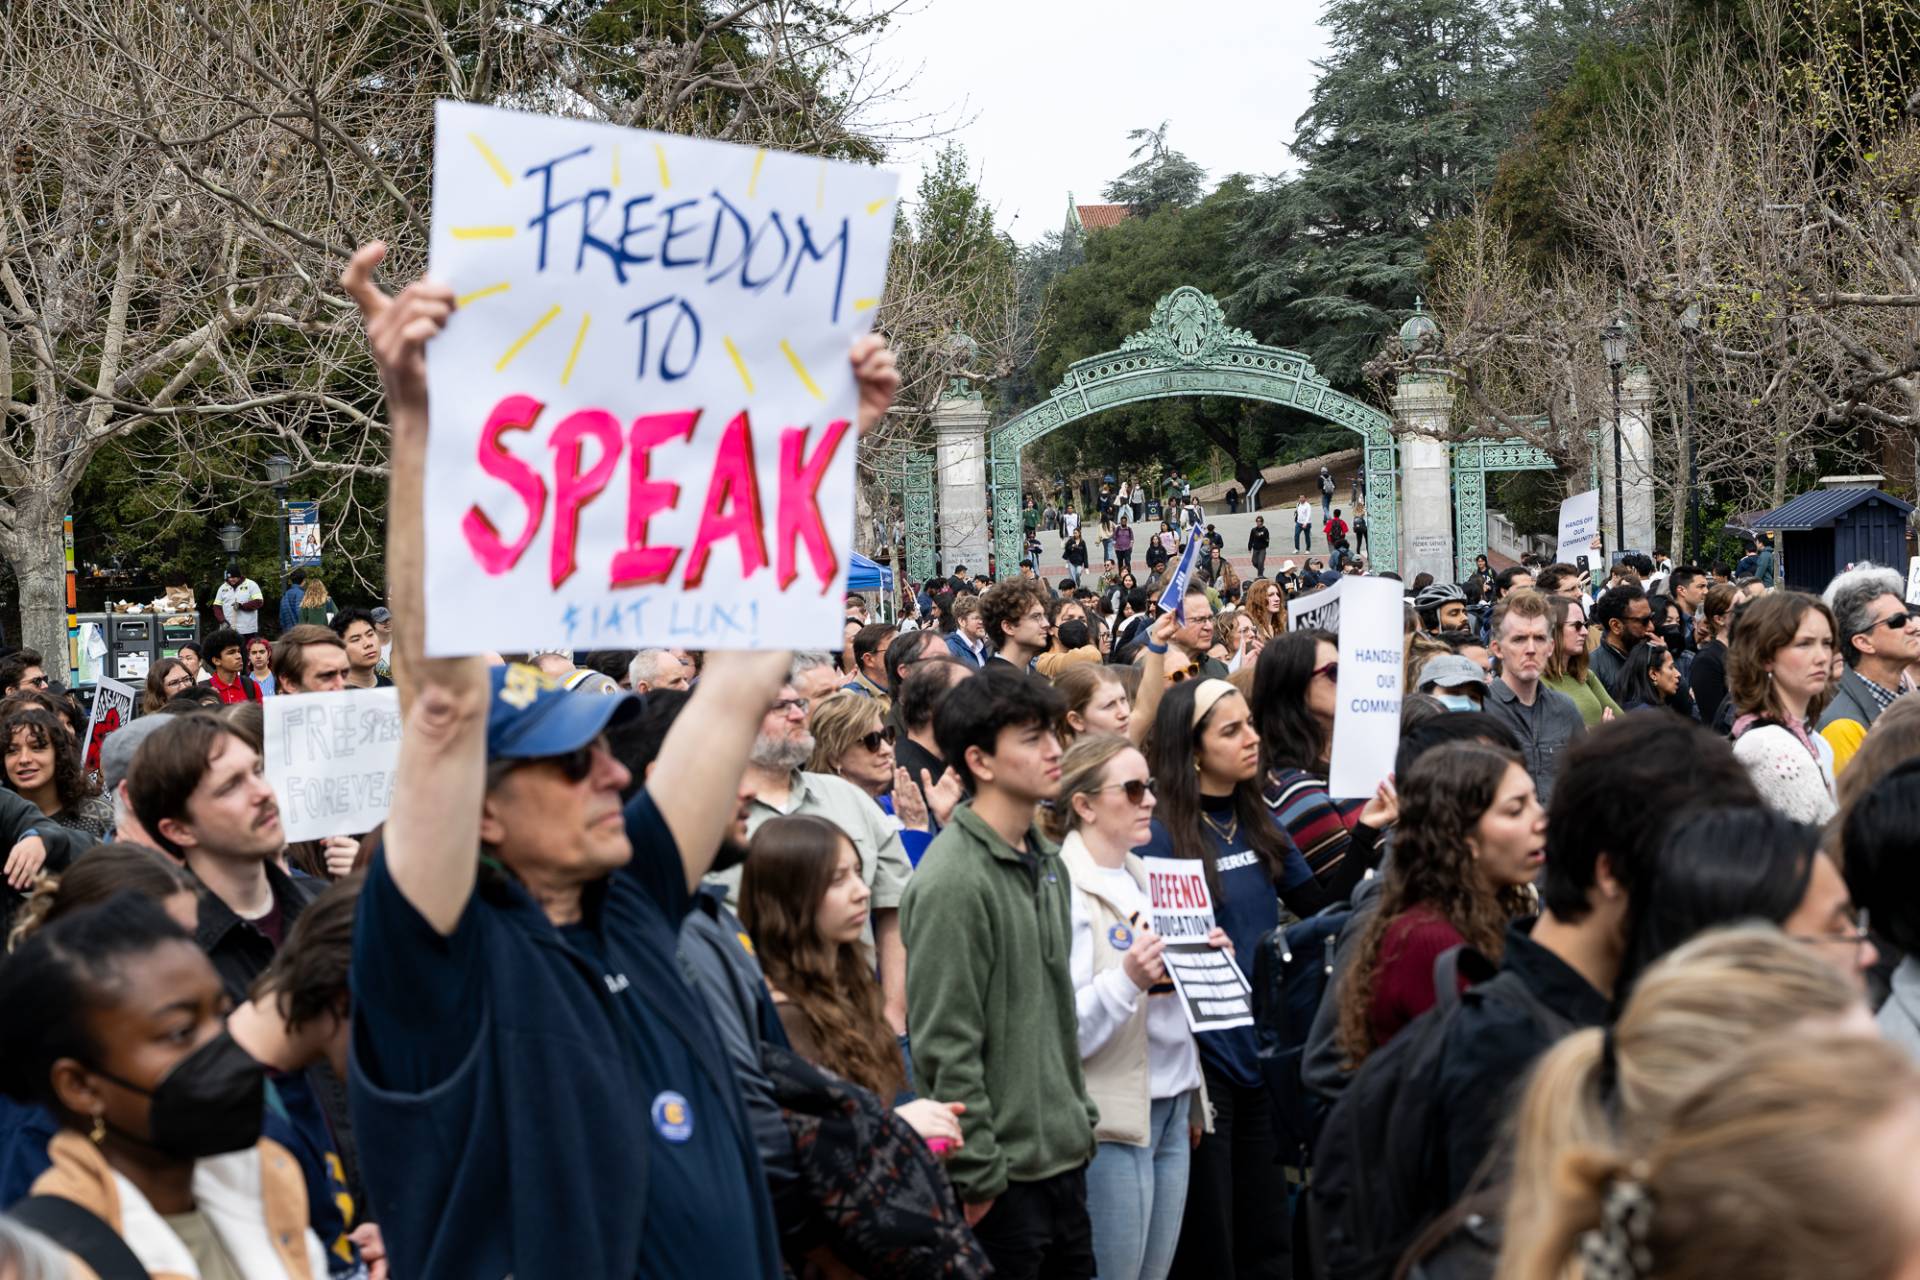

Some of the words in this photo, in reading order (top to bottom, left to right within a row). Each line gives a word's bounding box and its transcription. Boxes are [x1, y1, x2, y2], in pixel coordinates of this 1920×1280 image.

[523, 146, 851, 324] FREEDOM
[626, 295, 702, 381] TO
[461, 393, 852, 594] SPEAK
[1565, 517, 1584, 528] HANDS
[1573, 527, 1585, 536] OUR
[560, 596, 652, 642] FIAT
[1355, 649, 1393, 664] HANDS
[1376, 673, 1396, 689] OUR
[1149, 872, 1208, 909] DEFEND
